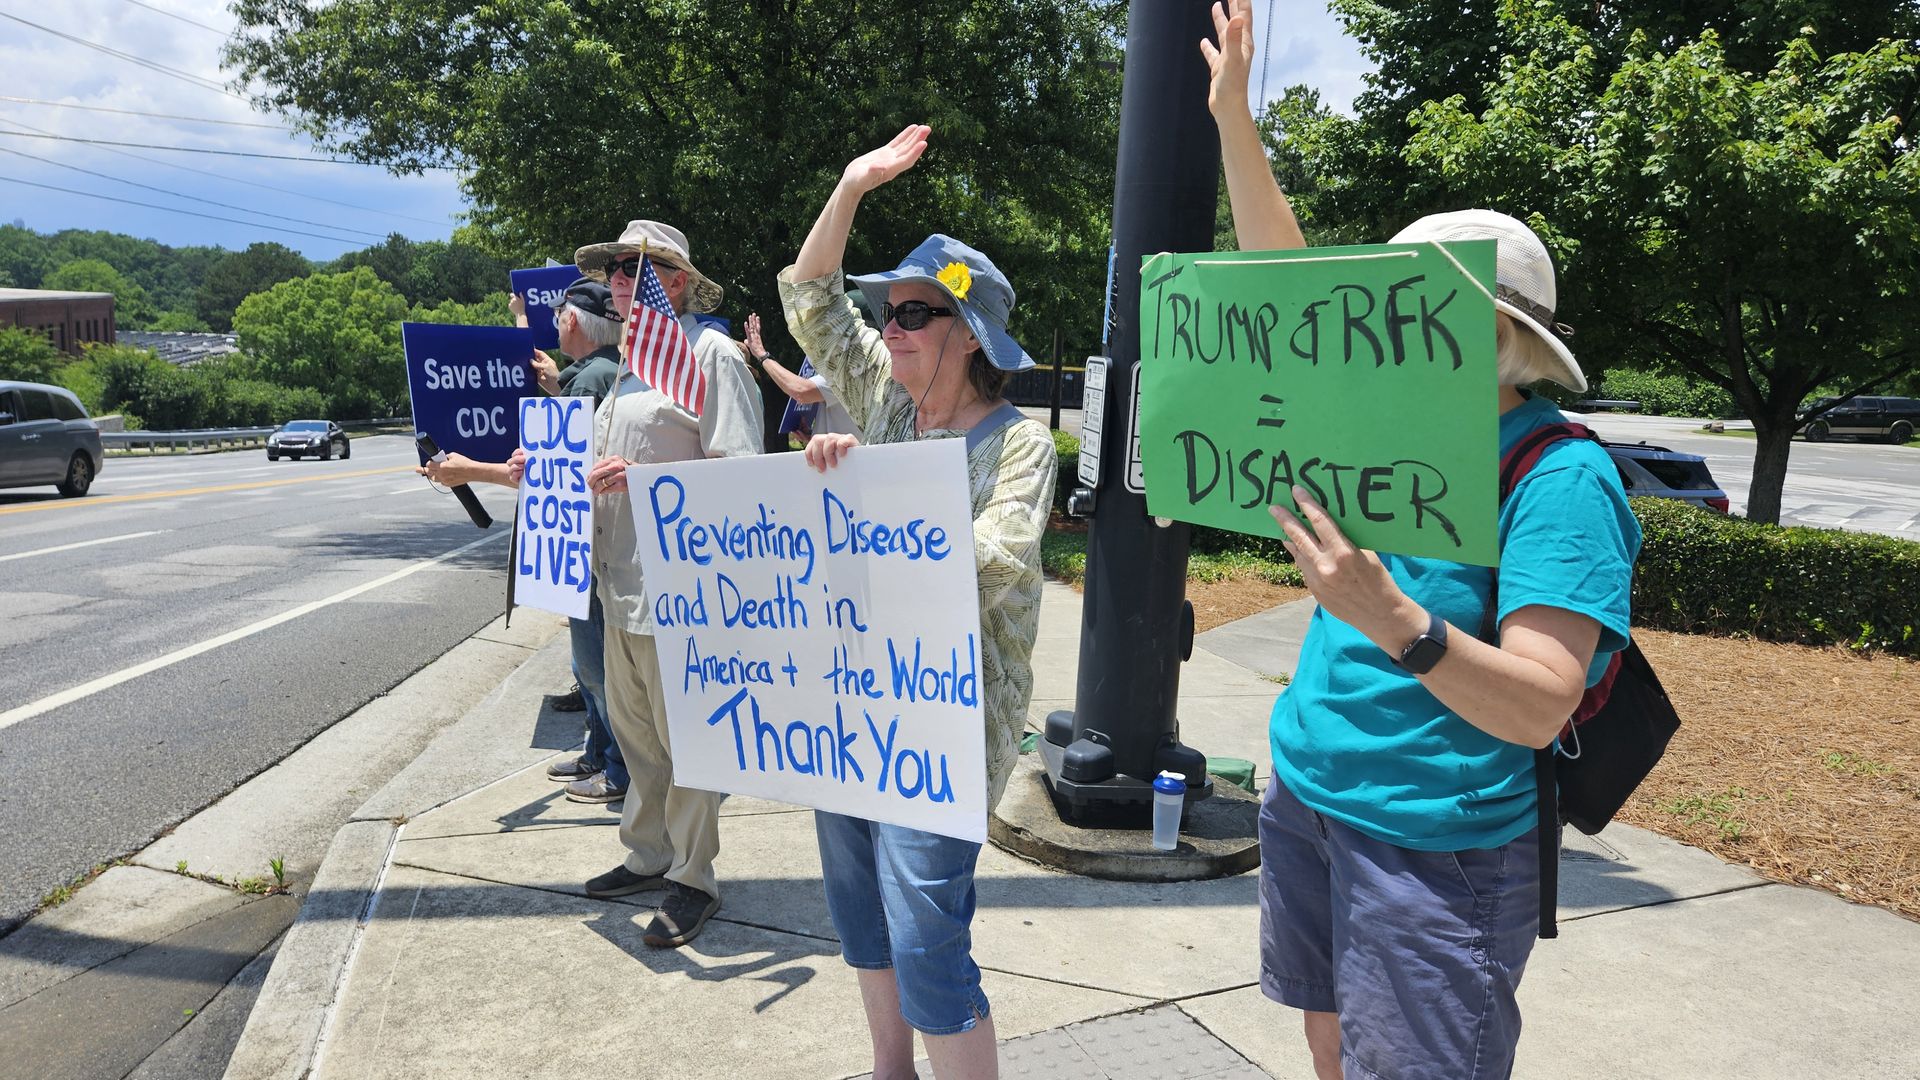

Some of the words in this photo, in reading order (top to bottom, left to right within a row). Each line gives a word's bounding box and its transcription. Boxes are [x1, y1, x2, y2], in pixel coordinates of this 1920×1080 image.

[527, 287, 567, 306] Sav
[1147, 265, 1280, 373] TRUMP
[1331, 274, 1463, 371] RFK
[424, 358, 482, 389] Save
[486, 358, 525, 388] the
[456, 406, 507, 439] CDC
[520, 399, 588, 453] CDC
[525, 456, 586, 493] CUTS
[1173, 430, 1463, 548] DISASTER
[525, 494, 590, 535] COST
[649, 475, 816, 585] Preventing
[822, 487, 953, 562] Disease
[520, 531, 591, 593] LIVES
[655, 576, 710, 629] and
[716, 572, 809, 630] Death
[823, 583, 868, 633] in
[684, 635, 775, 696] America
[781, 650, 799, 688] +
[822, 643, 885, 700] the
[887, 632, 979, 709] World
[706, 687, 865, 784] Thank
[862, 708, 956, 804] You
